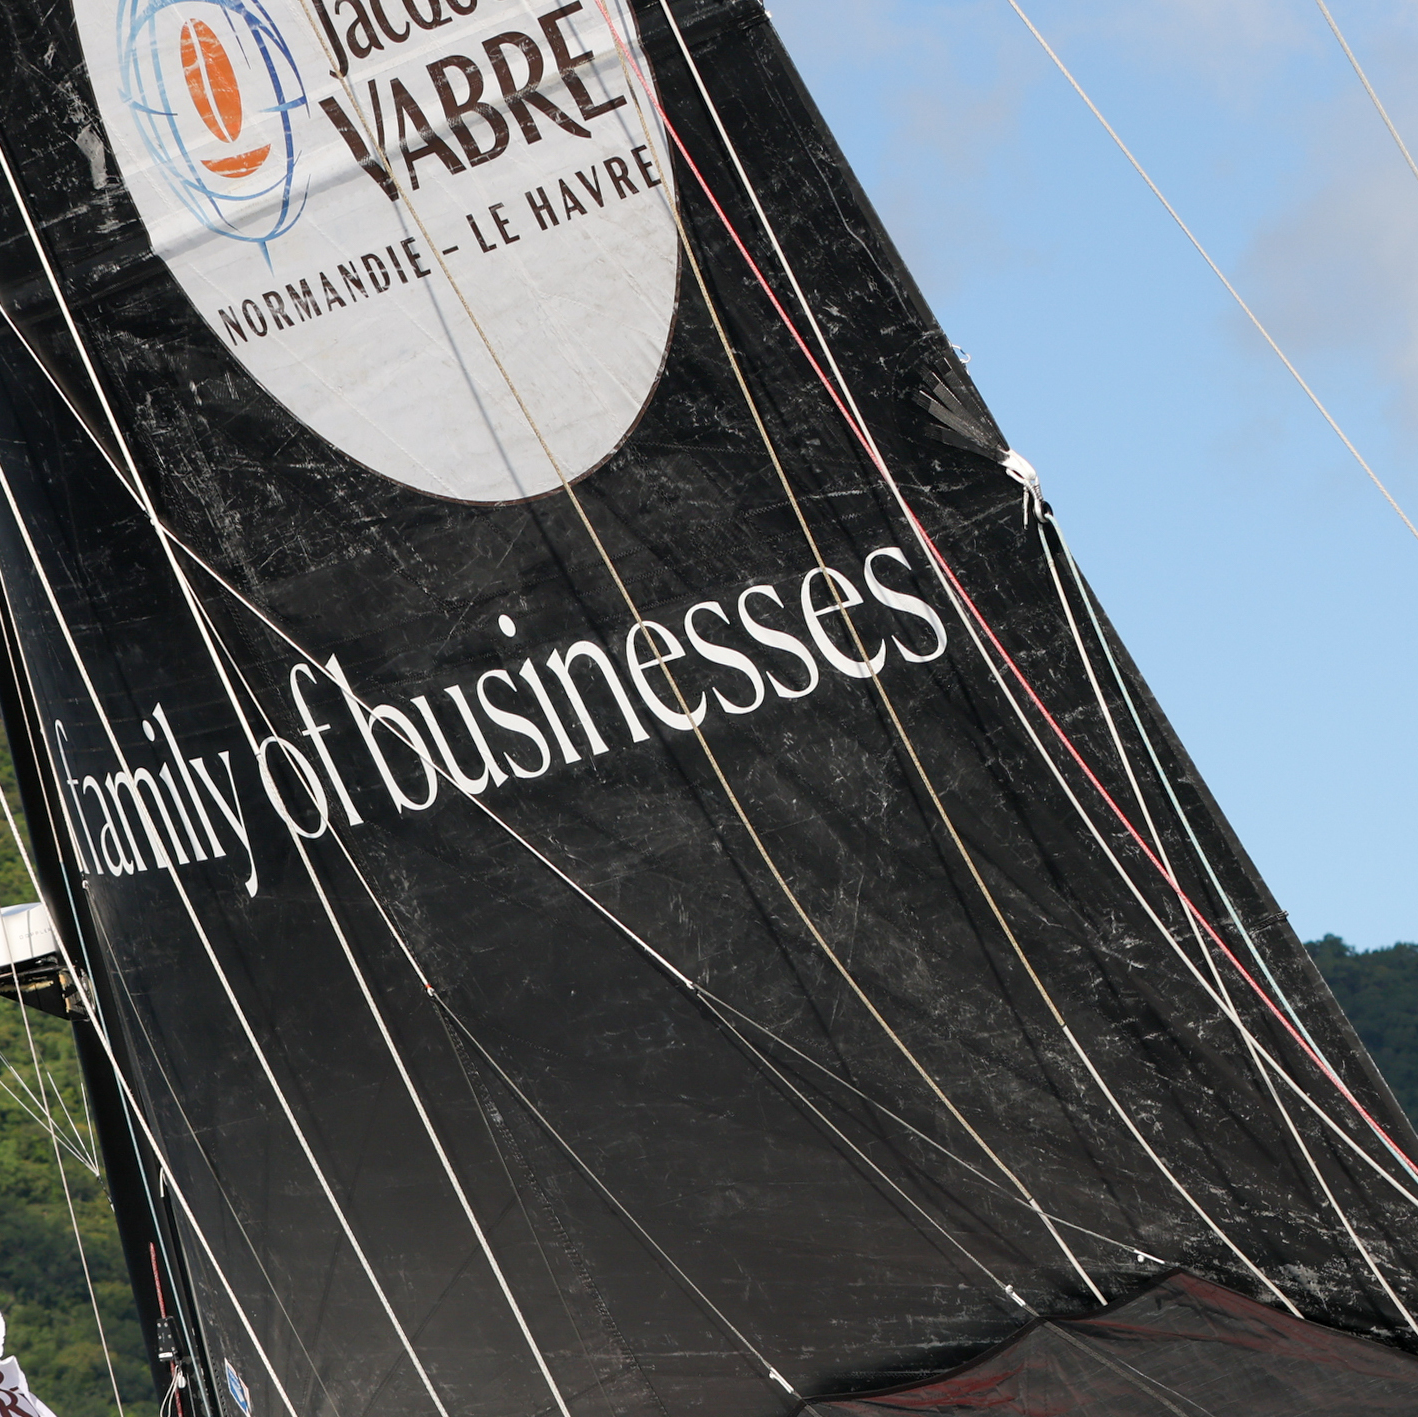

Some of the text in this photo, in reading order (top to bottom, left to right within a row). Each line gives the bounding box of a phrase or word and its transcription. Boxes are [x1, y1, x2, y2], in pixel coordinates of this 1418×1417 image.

[319, 1, 628, 202] VABRE
[218, 236, 431, 346] NORMANDIE
[465, 201, 521, 254] LE
[524, 144, 663, 231] HAVRE
[54, 545, 948, 898] family of businesses
